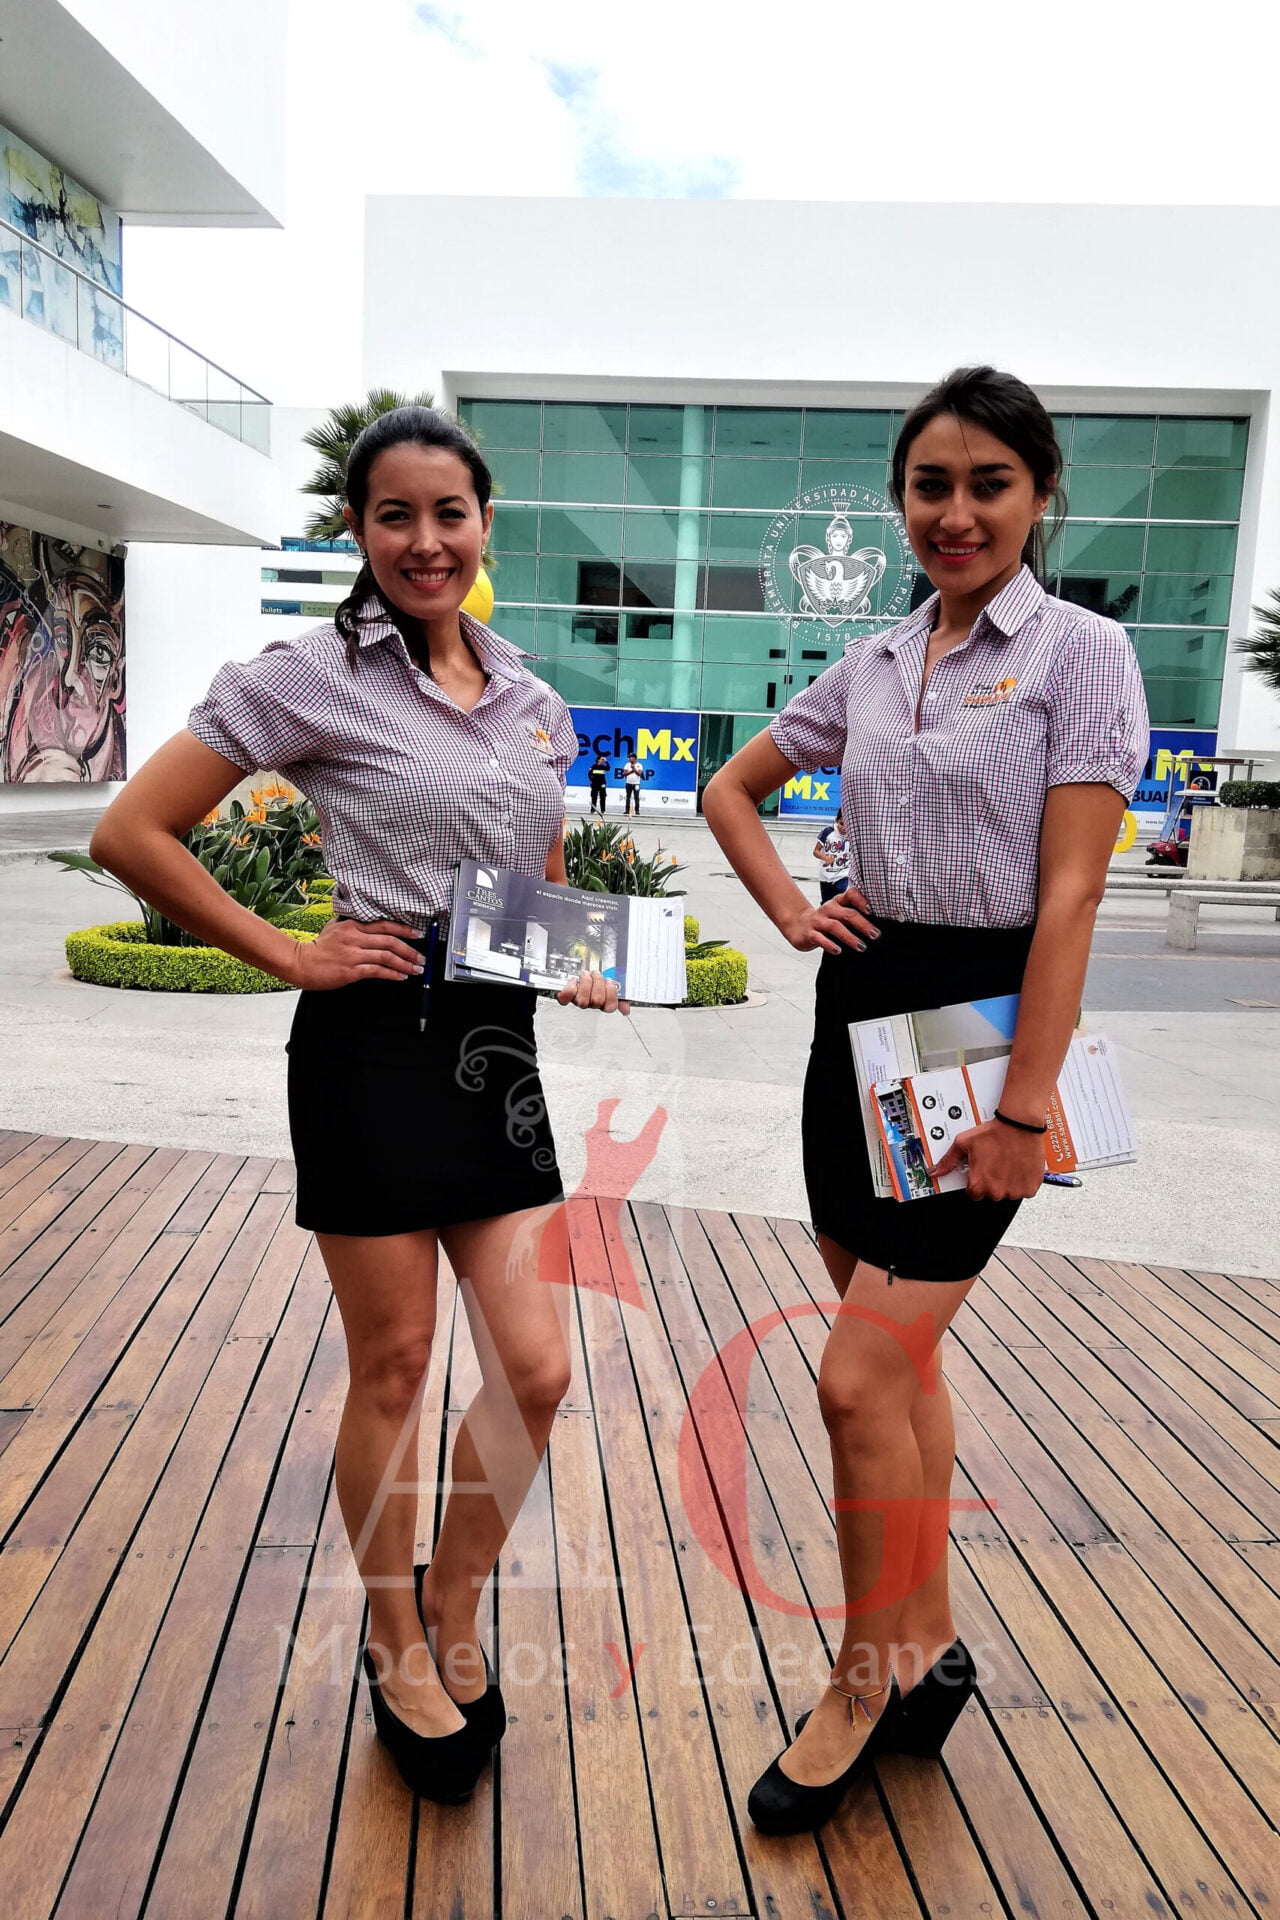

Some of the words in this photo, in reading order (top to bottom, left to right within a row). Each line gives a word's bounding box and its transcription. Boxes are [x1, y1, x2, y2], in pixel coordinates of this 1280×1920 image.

[771, 488, 857, 538] UNIVERSIDAD
[578, 728, 696, 762] echMx
[614, 768, 655, 781] BAP
[467, 890, 504, 907] CANTOS
[475, 886, 496, 899] TRES
[1050, 1131, 1061, 1153] (222)
